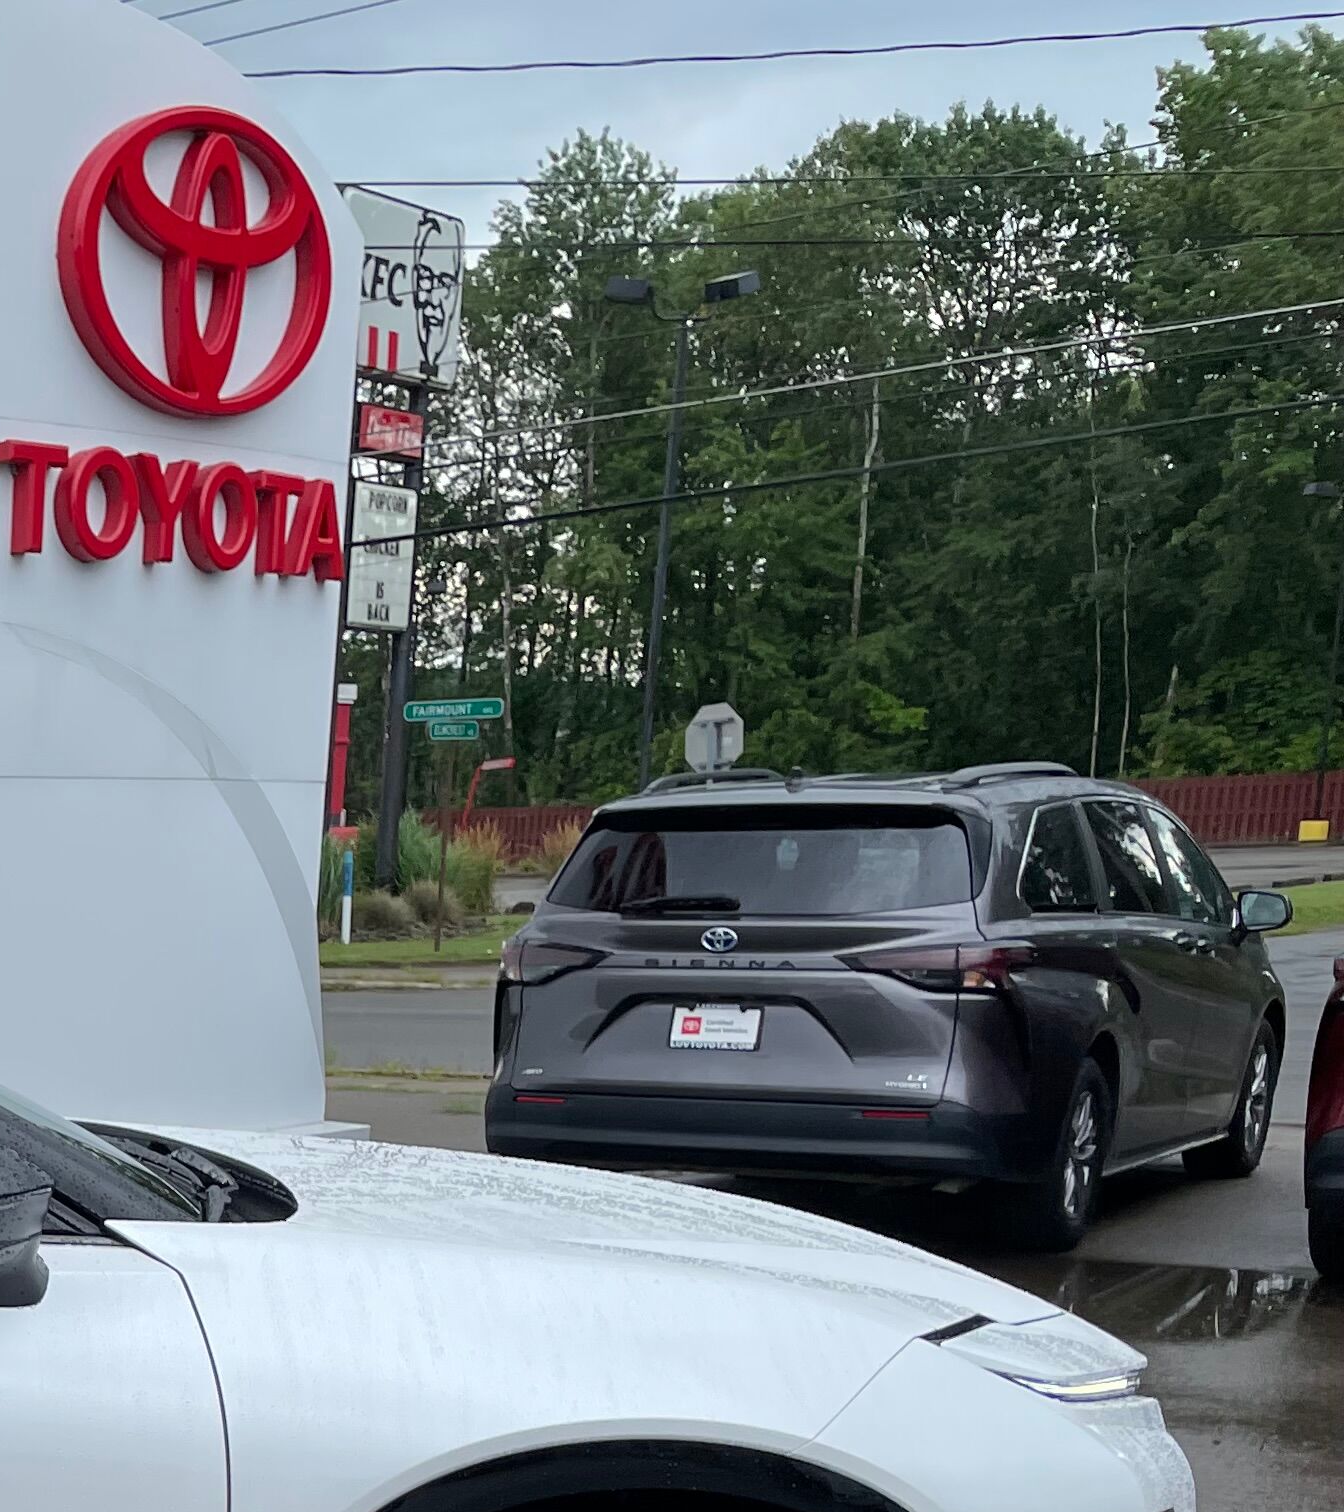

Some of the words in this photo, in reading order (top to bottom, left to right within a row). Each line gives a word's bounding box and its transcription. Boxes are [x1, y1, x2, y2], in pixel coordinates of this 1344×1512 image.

[368, 490, 408, 515] POPCORN
[376, 580, 385, 599] IS
[367, 602, 390, 623] BACK
[412, 703, 473, 718] FAIRMOUNT
[644, 957, 797, 969] SIENNA
